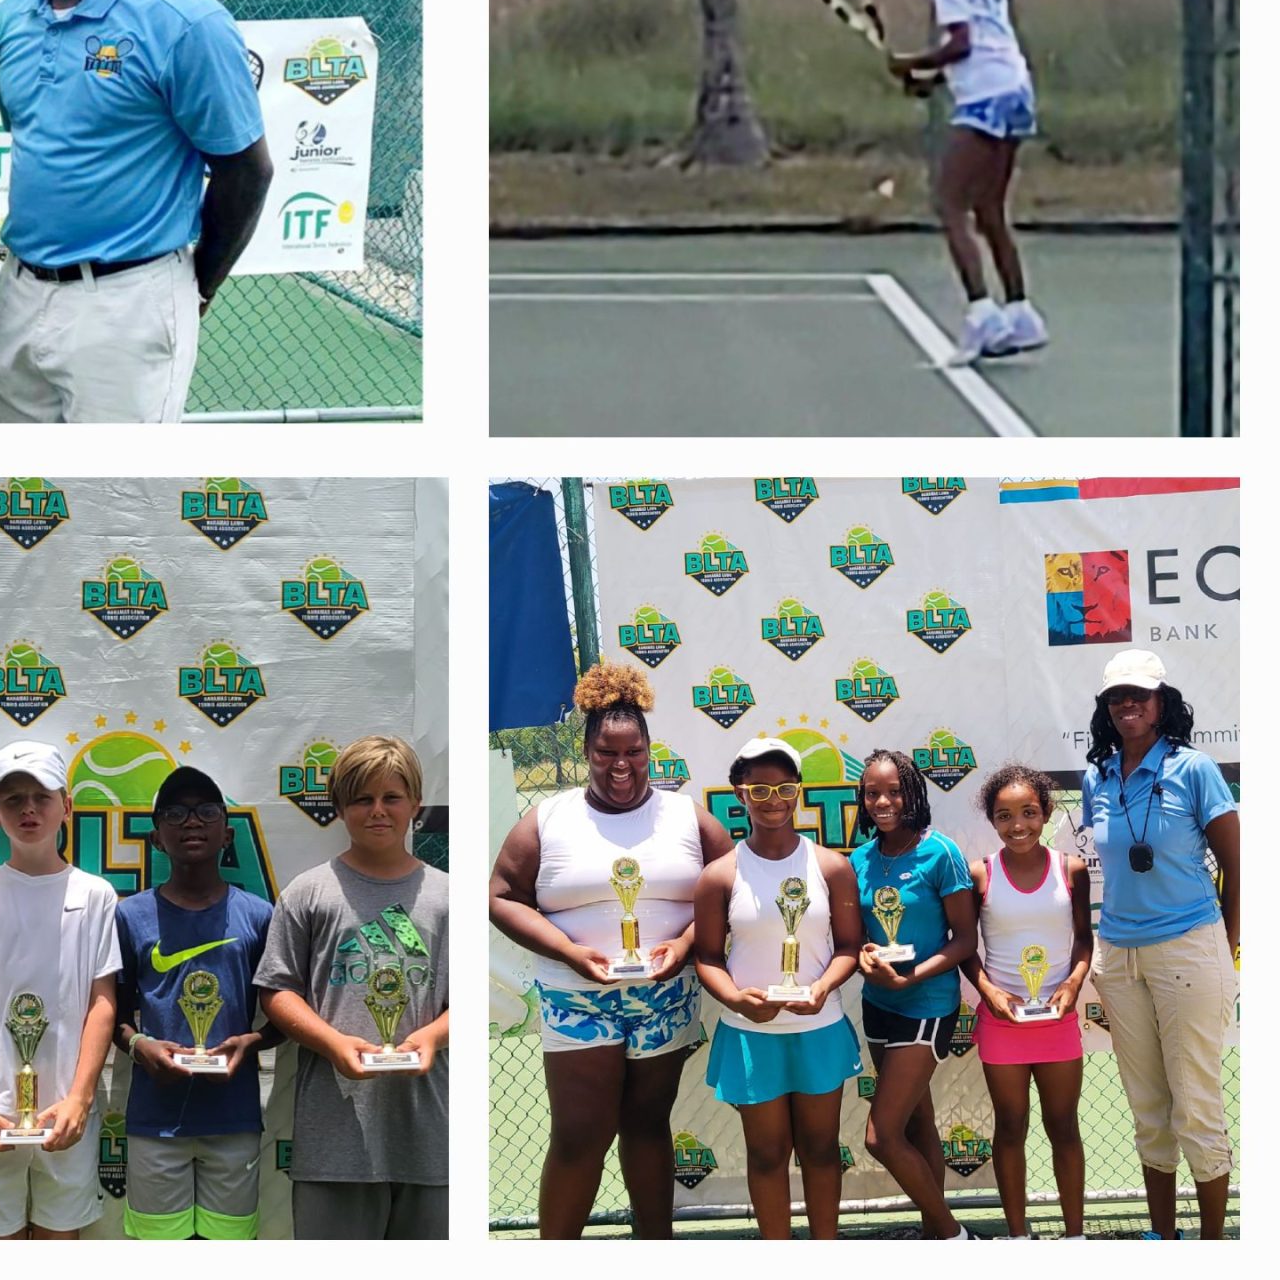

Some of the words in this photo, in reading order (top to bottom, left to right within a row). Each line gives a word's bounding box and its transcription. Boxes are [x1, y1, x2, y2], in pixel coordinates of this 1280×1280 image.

[284, 56, 367, 82] BLTA
[290, 146, 341, 161] junior
[283, 210, 331, 240] ITF
[609, 483, 673, 508] BLTA
[755, 477, 819, 501] BLTA
[182, 492, 267, 520] BLTA
[685, 551, 749, 575] BLTA
[830, 543, 894, 568] BLTA
[83, 581, 168, 609] BLTA
[282, 581, 369, 609] BLTA
[761, 616, 824, 640] BLTA
[907, 607, 972, 632] BLTA
[619, 623, 681, 647] BLTA
[1150, 624, 1219, 641] BANK
[180, 667, 266, 696] BLTA
[835, 676, 899, 702] BLTA
[692, 684, 756, 708] BLTA
[913, 746, 977, 770] BLTA
